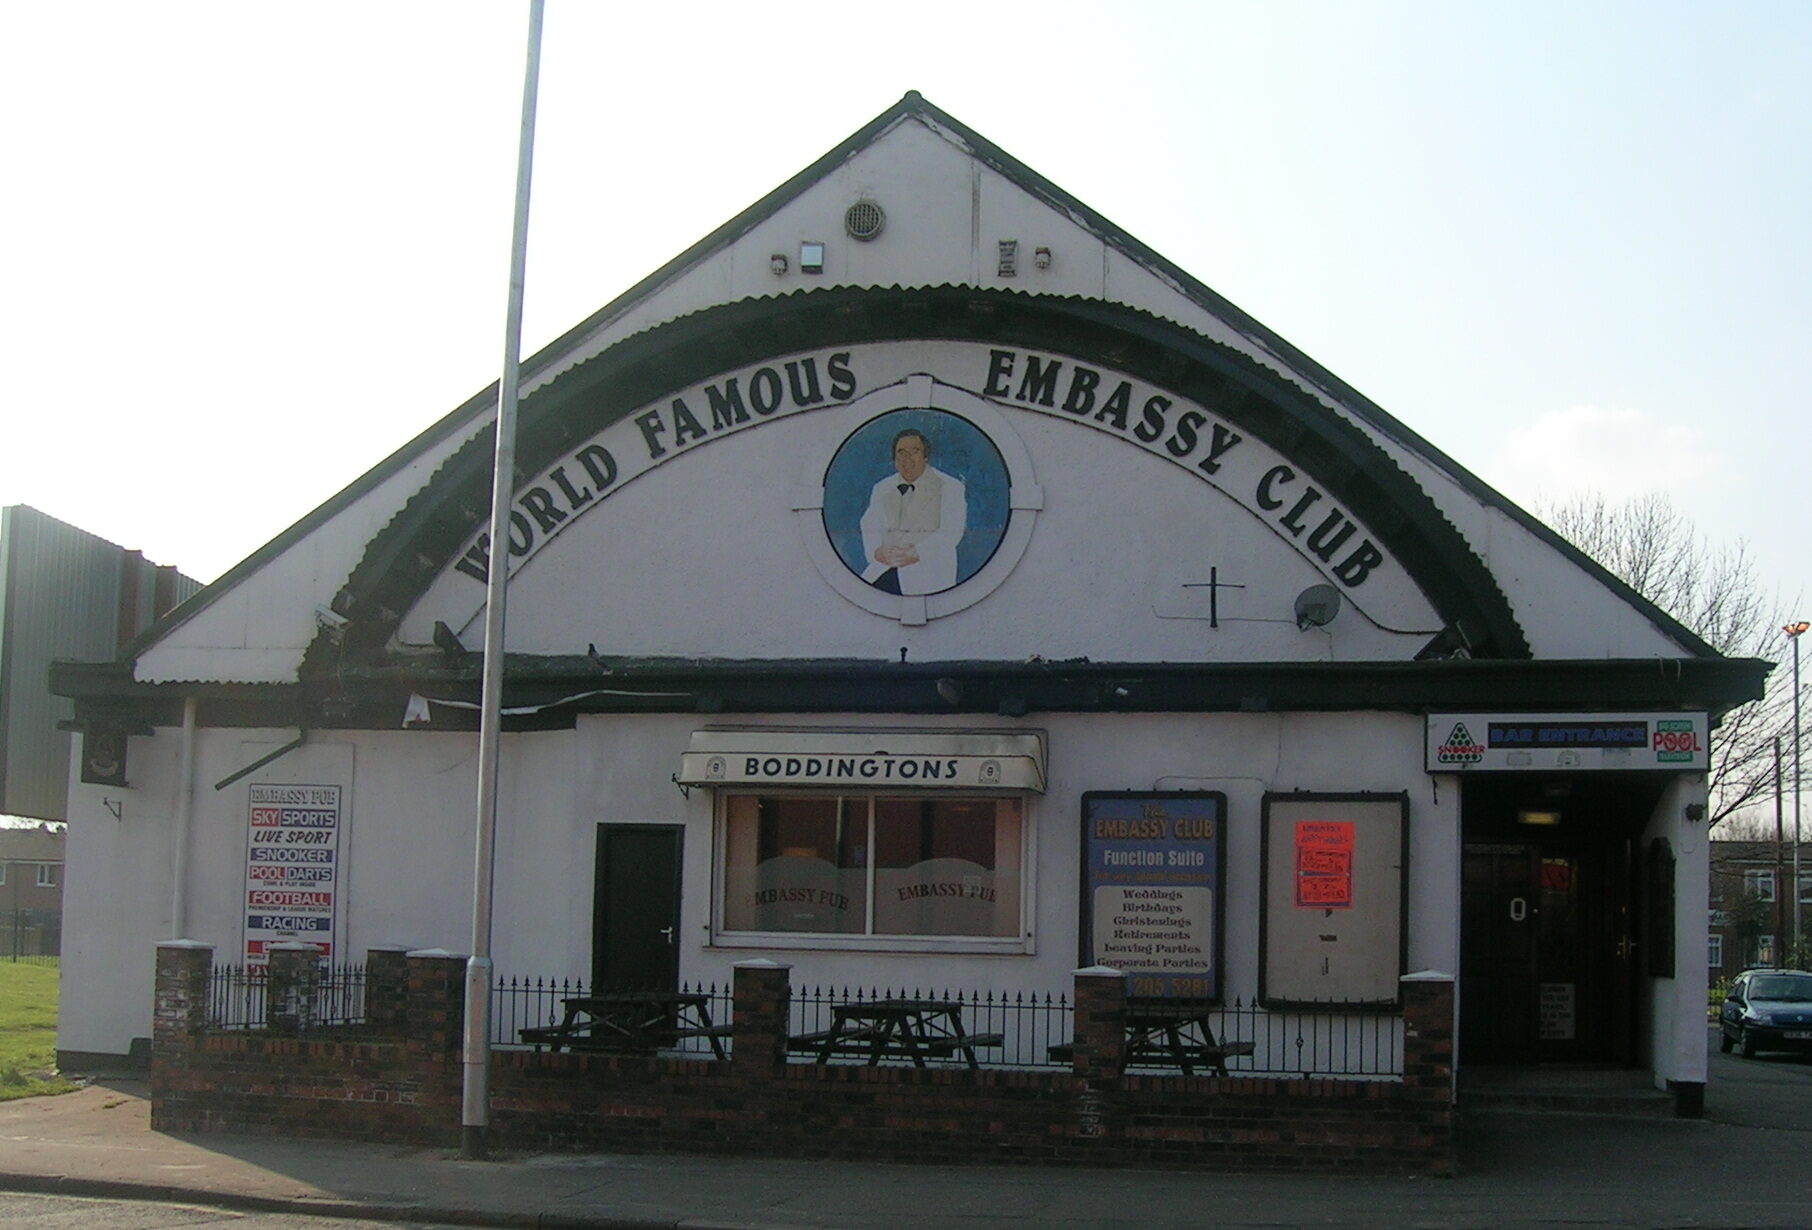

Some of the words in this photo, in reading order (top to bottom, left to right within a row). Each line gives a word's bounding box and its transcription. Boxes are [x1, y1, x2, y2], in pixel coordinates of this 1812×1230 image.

[454, 443, 618, 584] WORLD
[635, 352, 857, 459] FAMOUS
[983, 350, 1241, 475] EMBASSY
[1256, 465, 1385, 589] CLUB
[1490, 728, 1533, 742] BAR
[1538, 727, 1646, 742] ENTRANCE
[1653, 731, 1702, 752] POOL
[1438, 745, 1486, 753] SNOOKER
[745, 758, 959, 780] BODDINGTONS
[252, 789, 308, 804] EMBASSY
[311, 790, 336, 805] PUB
[252, 810, 279, 825] SKY
[282, 811, 335, 826] SPORTS
[1095, 819, 1169, 839] EMBASSY
[1174, 819, 1215, 840] CLUB
[254, 830, 283, 843] LIVE
[285, 831, 332, 844] SPORT
[255, 849, 328, 862] SNOOKER
[1103, 849, 1164, 866] Function
[1168, 850, 1205, 866] Suite
[251, 867, 284, 880] POOL
[288, 868, 332, 881] DARTS
[252, 892, 329, 905] FOOTBALL
[819, 889, 850, 912] PUB
[1122, 889, 1184, 901] Weddings
[1122, 902, 1184, 914] Birthdays
[262, 917, 318, 930] RACING
[1113, 916, 1193, 928] Christenings
[1113, 929, 1191, 940] Retirements
[1104, 943, 1153, 955] Leaving
[1155, 944, 1202, 954] Parties
[1096, 957, 1159, 969] Corporate
[1162, 958, 1209, 969] Parties
